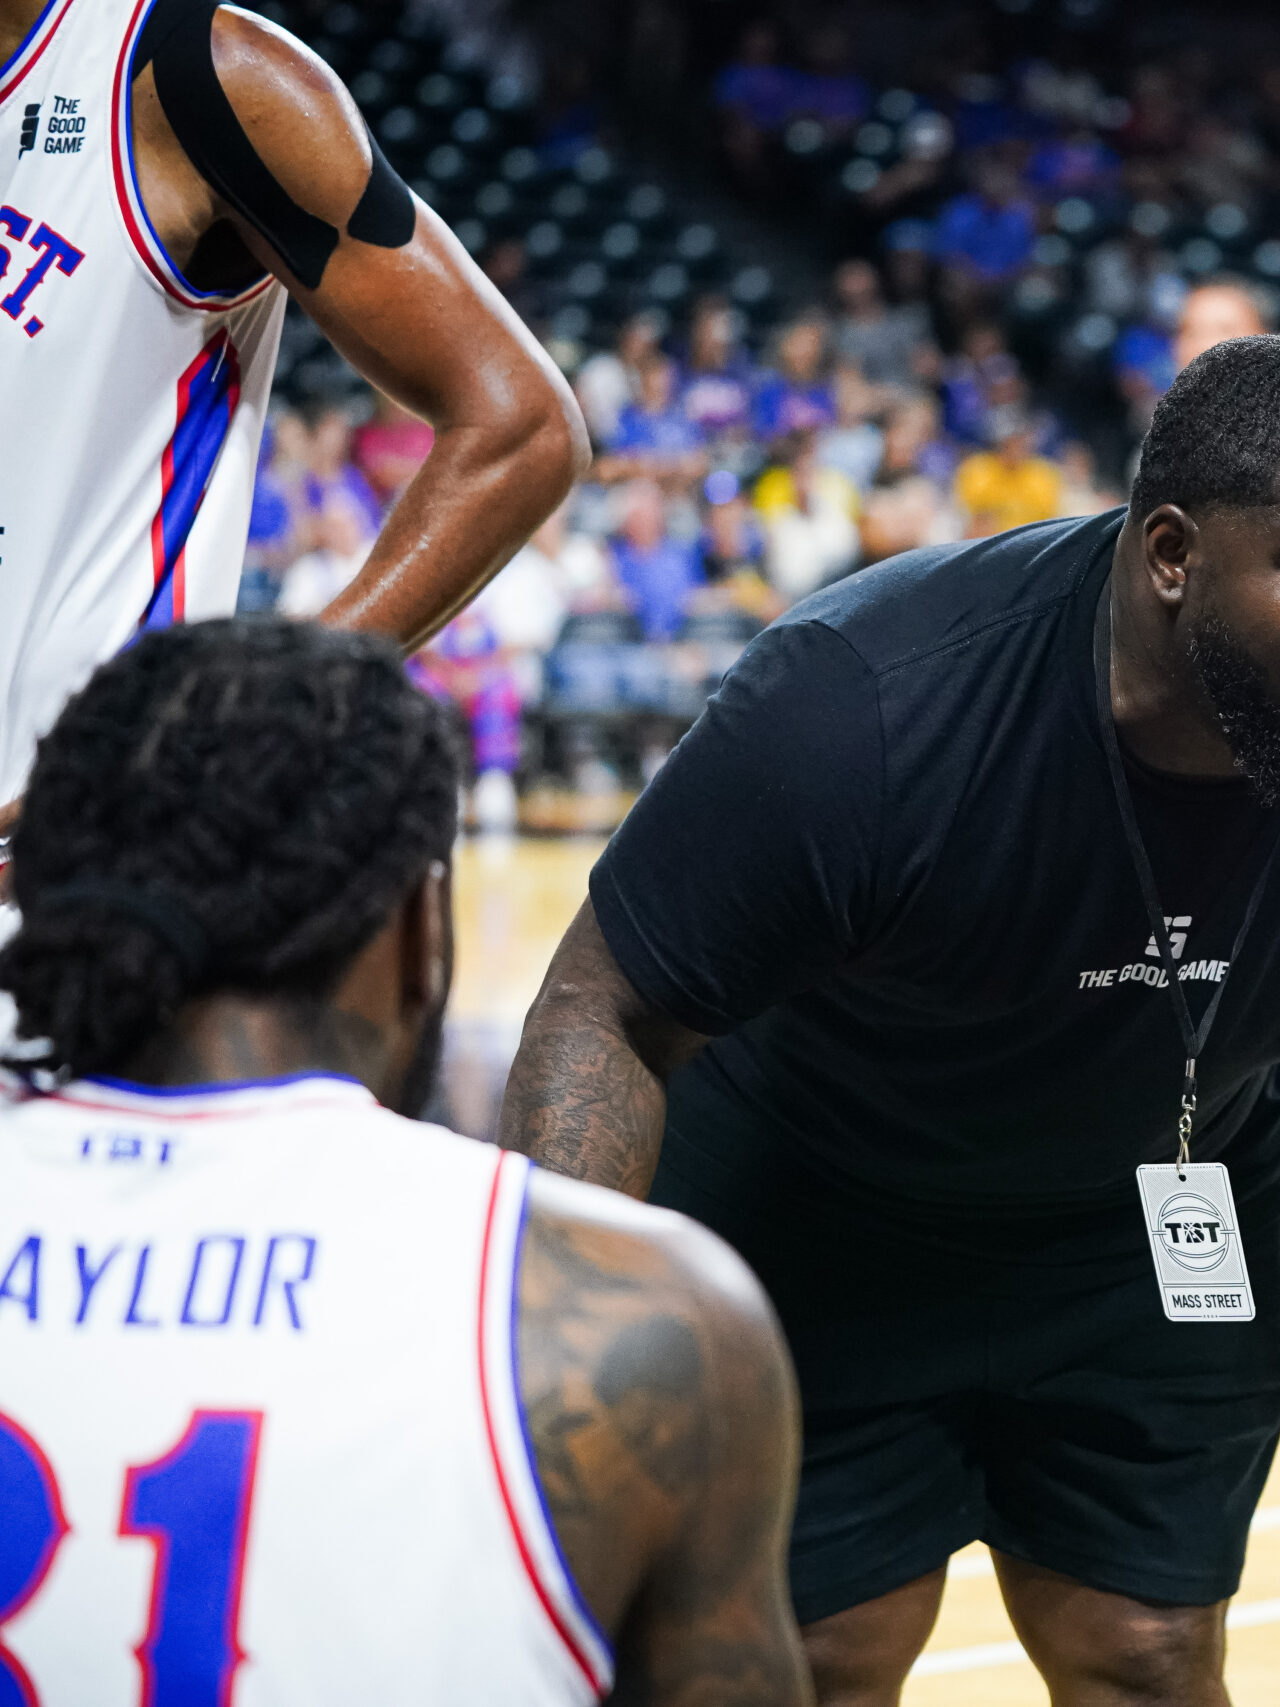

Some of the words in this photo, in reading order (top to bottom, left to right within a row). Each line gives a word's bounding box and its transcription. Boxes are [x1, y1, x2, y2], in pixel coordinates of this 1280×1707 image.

[53, 95, 81, 115] THE
[47, 116, 87, 134] GOOD
[44, 136, 85, 154] GAME
[1078, 969, 1118, 990] THE
[1177, 959, 1231, 983] GAME
[1171, 1294, 1202, 1309] MASS
[1204, 1294, 1243, 1309] STREET
